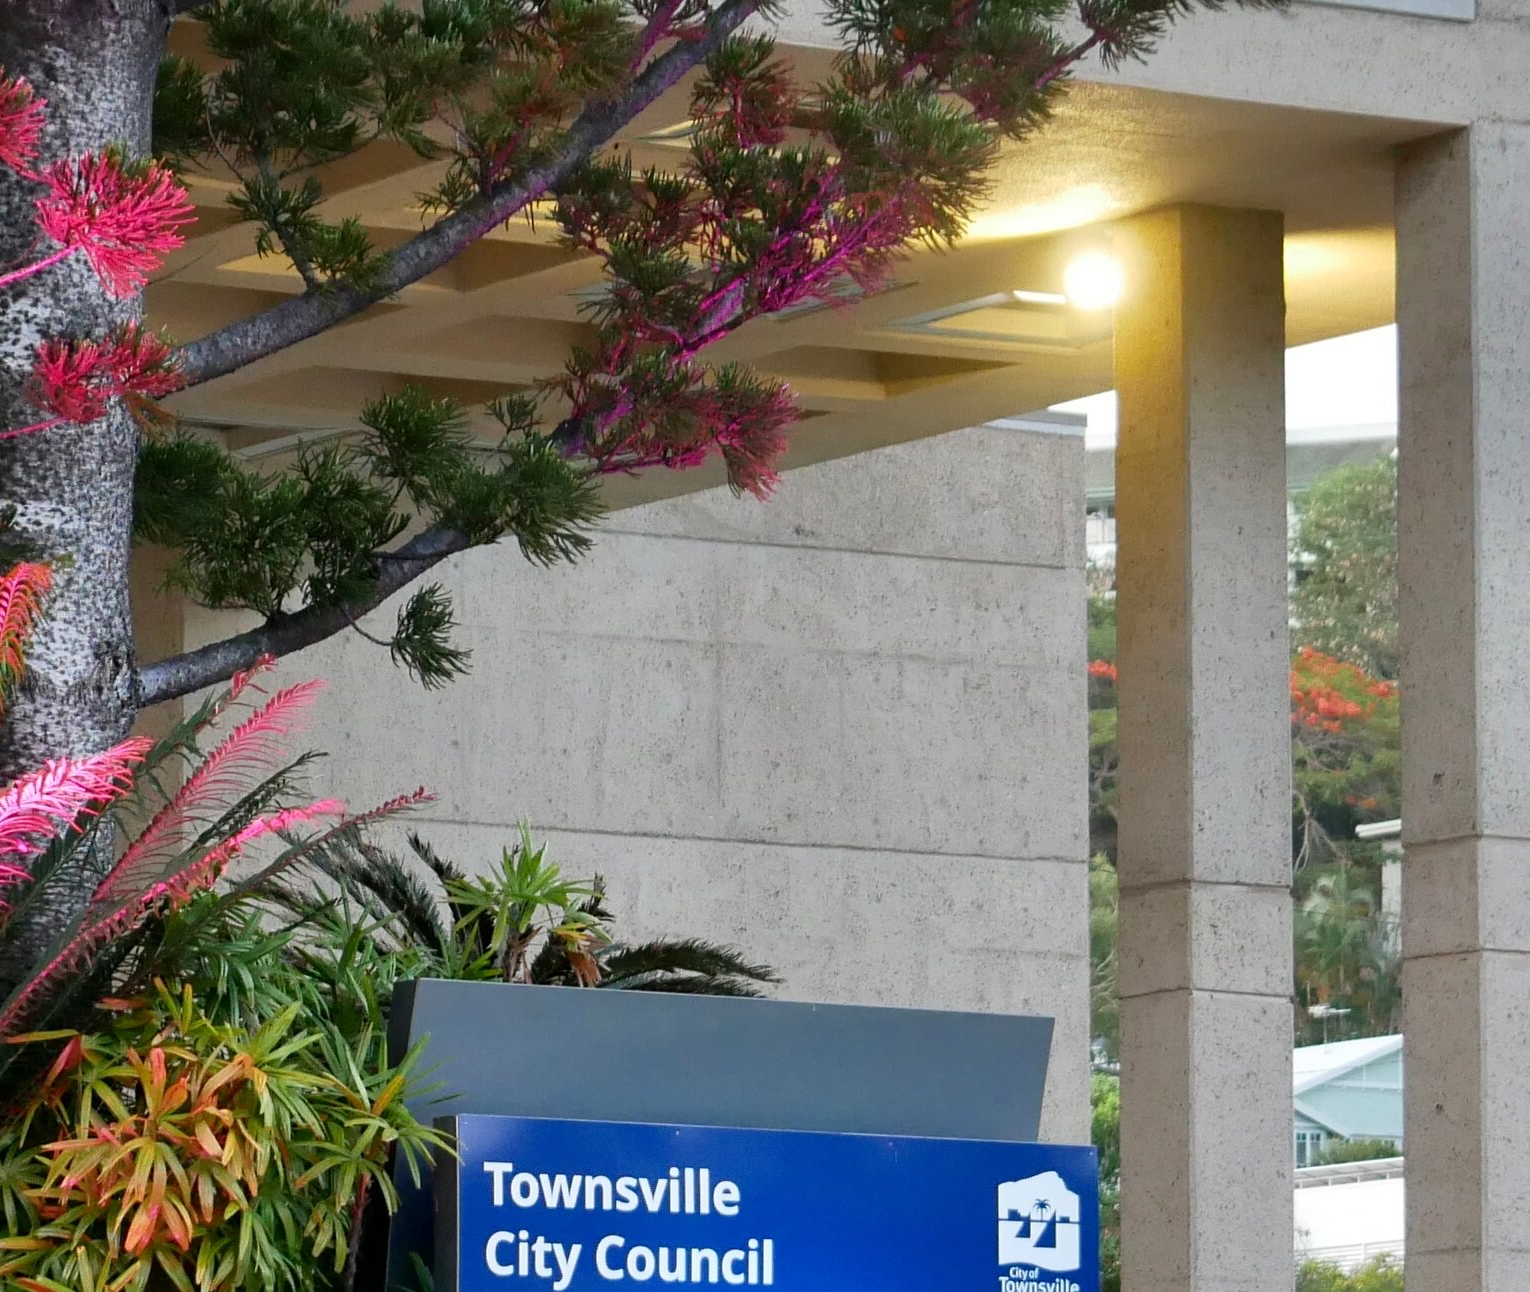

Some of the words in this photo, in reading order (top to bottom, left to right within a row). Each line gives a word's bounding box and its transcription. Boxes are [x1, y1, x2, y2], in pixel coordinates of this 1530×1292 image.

[483, 1161, 741, 1216] Townsville
[485, 1229, 582, 1291] City
[595, 1234, 774, 1286] Council
[1009, 1266, 1028, 1280] City
[1028, 1267, 1040, 1279] of
